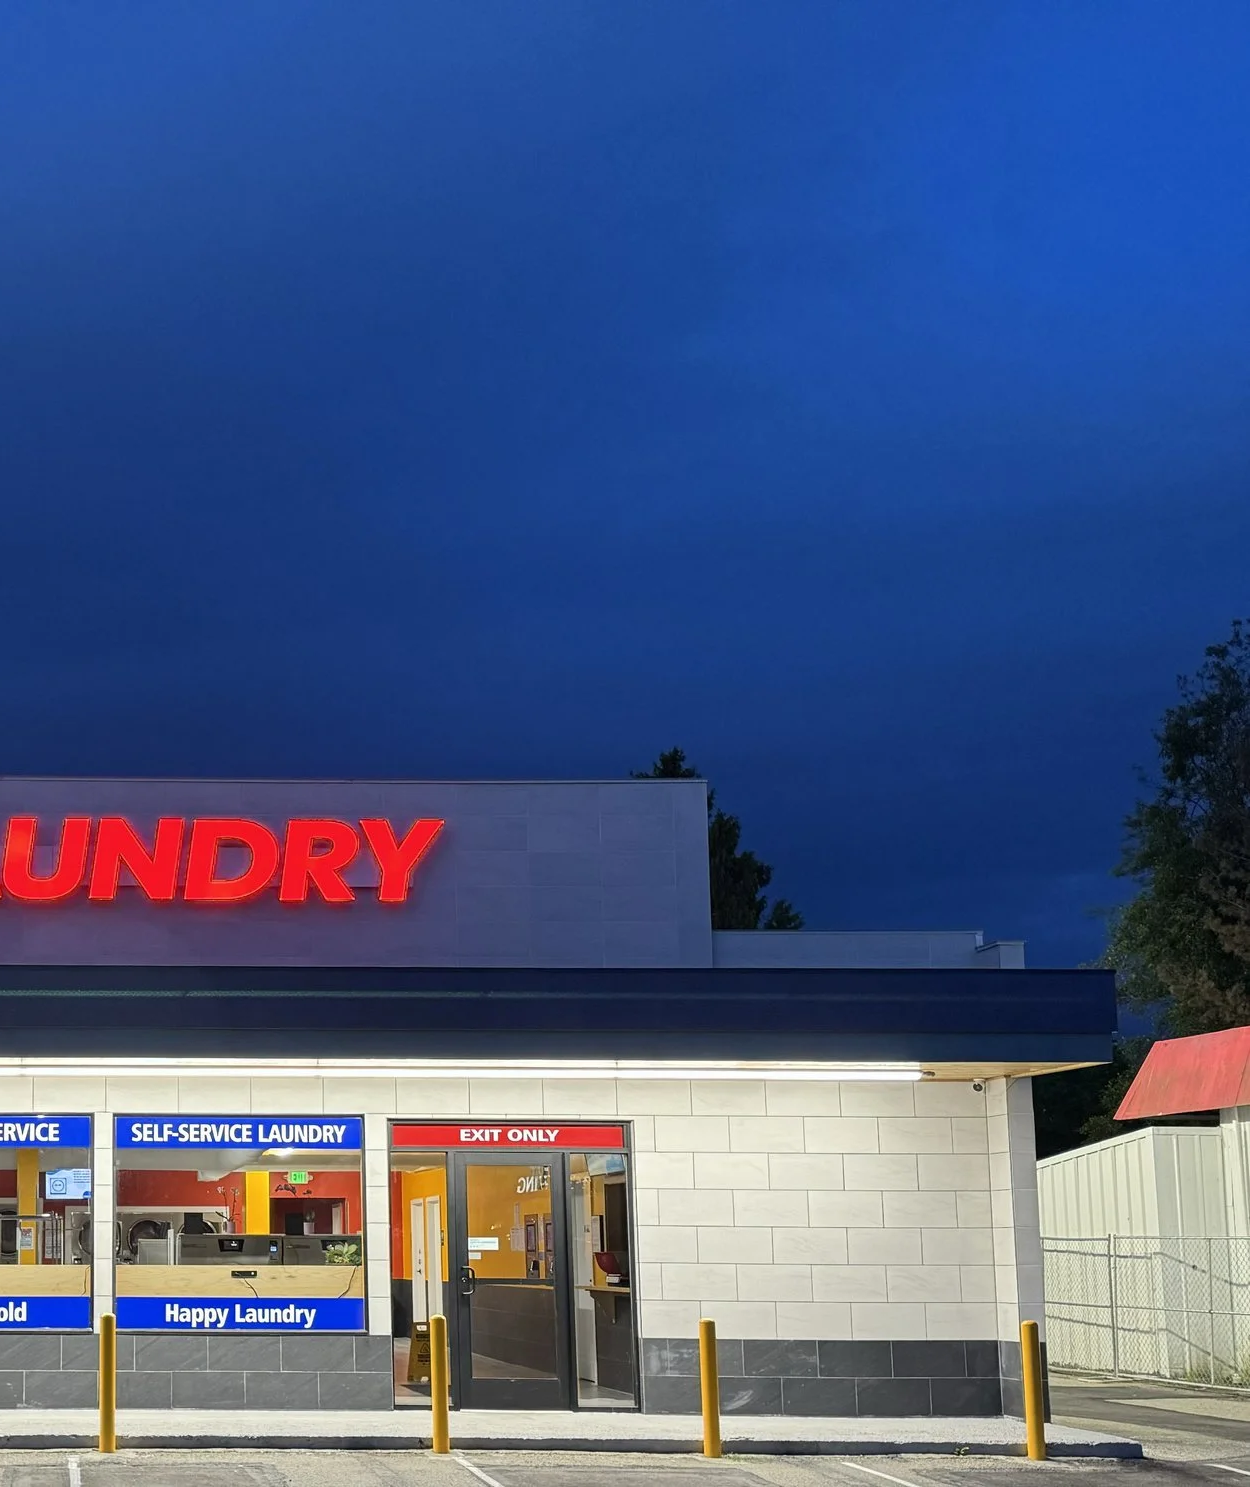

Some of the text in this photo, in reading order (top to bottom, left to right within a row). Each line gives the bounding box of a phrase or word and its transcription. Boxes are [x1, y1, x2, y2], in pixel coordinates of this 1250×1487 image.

[131, 1122, 347, 1145] SELF-SERVICE LAUNDRY
[459, 1128, 560, 1142] EXIT ONLY
[164, 1303, 317, 1329] Happy Laundry
